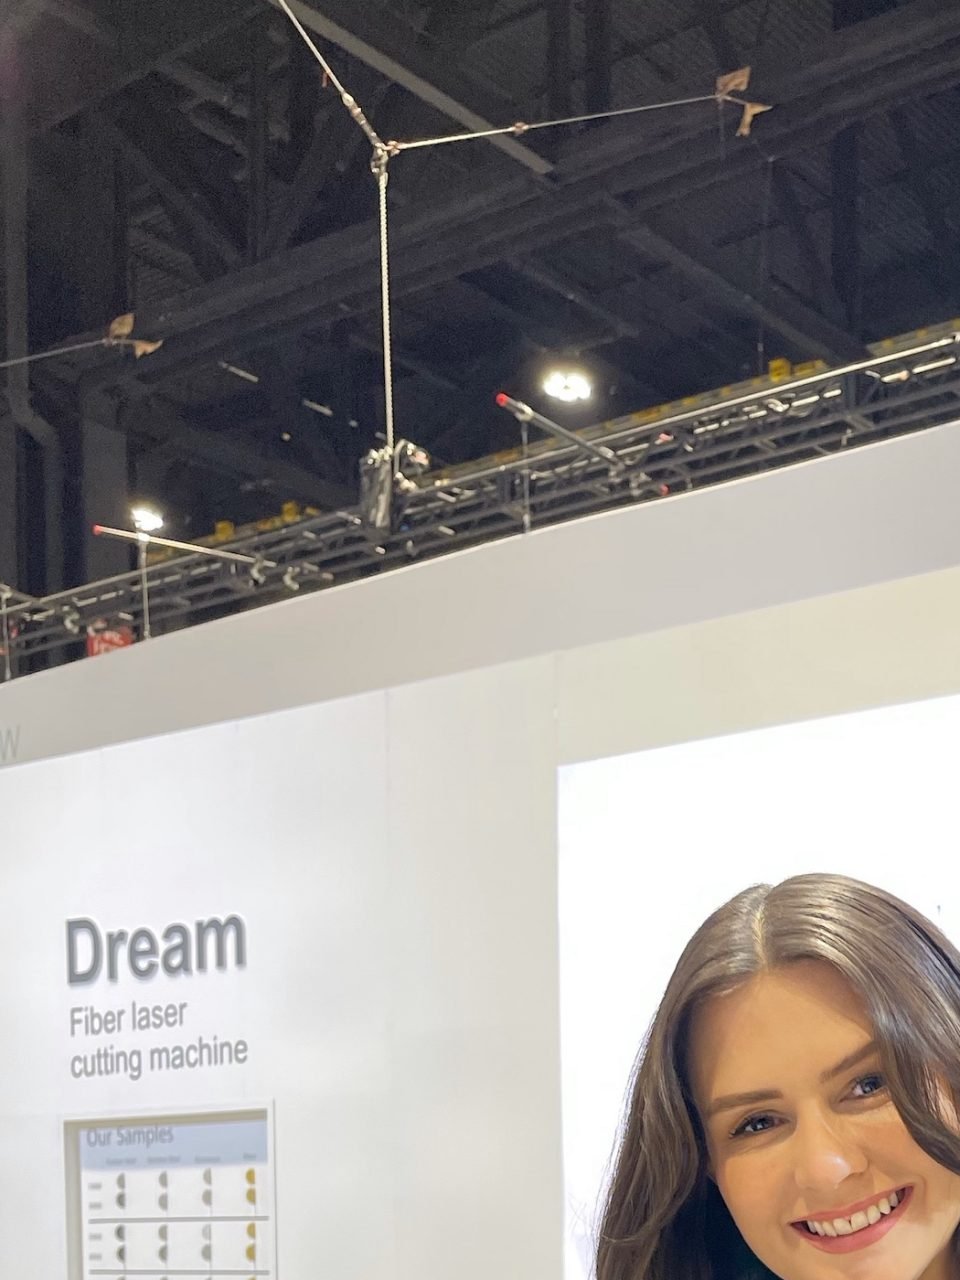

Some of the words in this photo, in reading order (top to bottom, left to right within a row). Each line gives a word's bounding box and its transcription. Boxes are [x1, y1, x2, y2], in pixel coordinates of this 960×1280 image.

[65, 913, 248, 988] Dream
[70, 1005, 126, 1037] Fiber
[132, 1000, 187, 1032] laser
[70, 1044, 142, 1081] cutting
[149, 1036, 248, 1072] machine
[86, 1128, 112, 1148] Our
[116, 1125, 174, 1150] Samples
